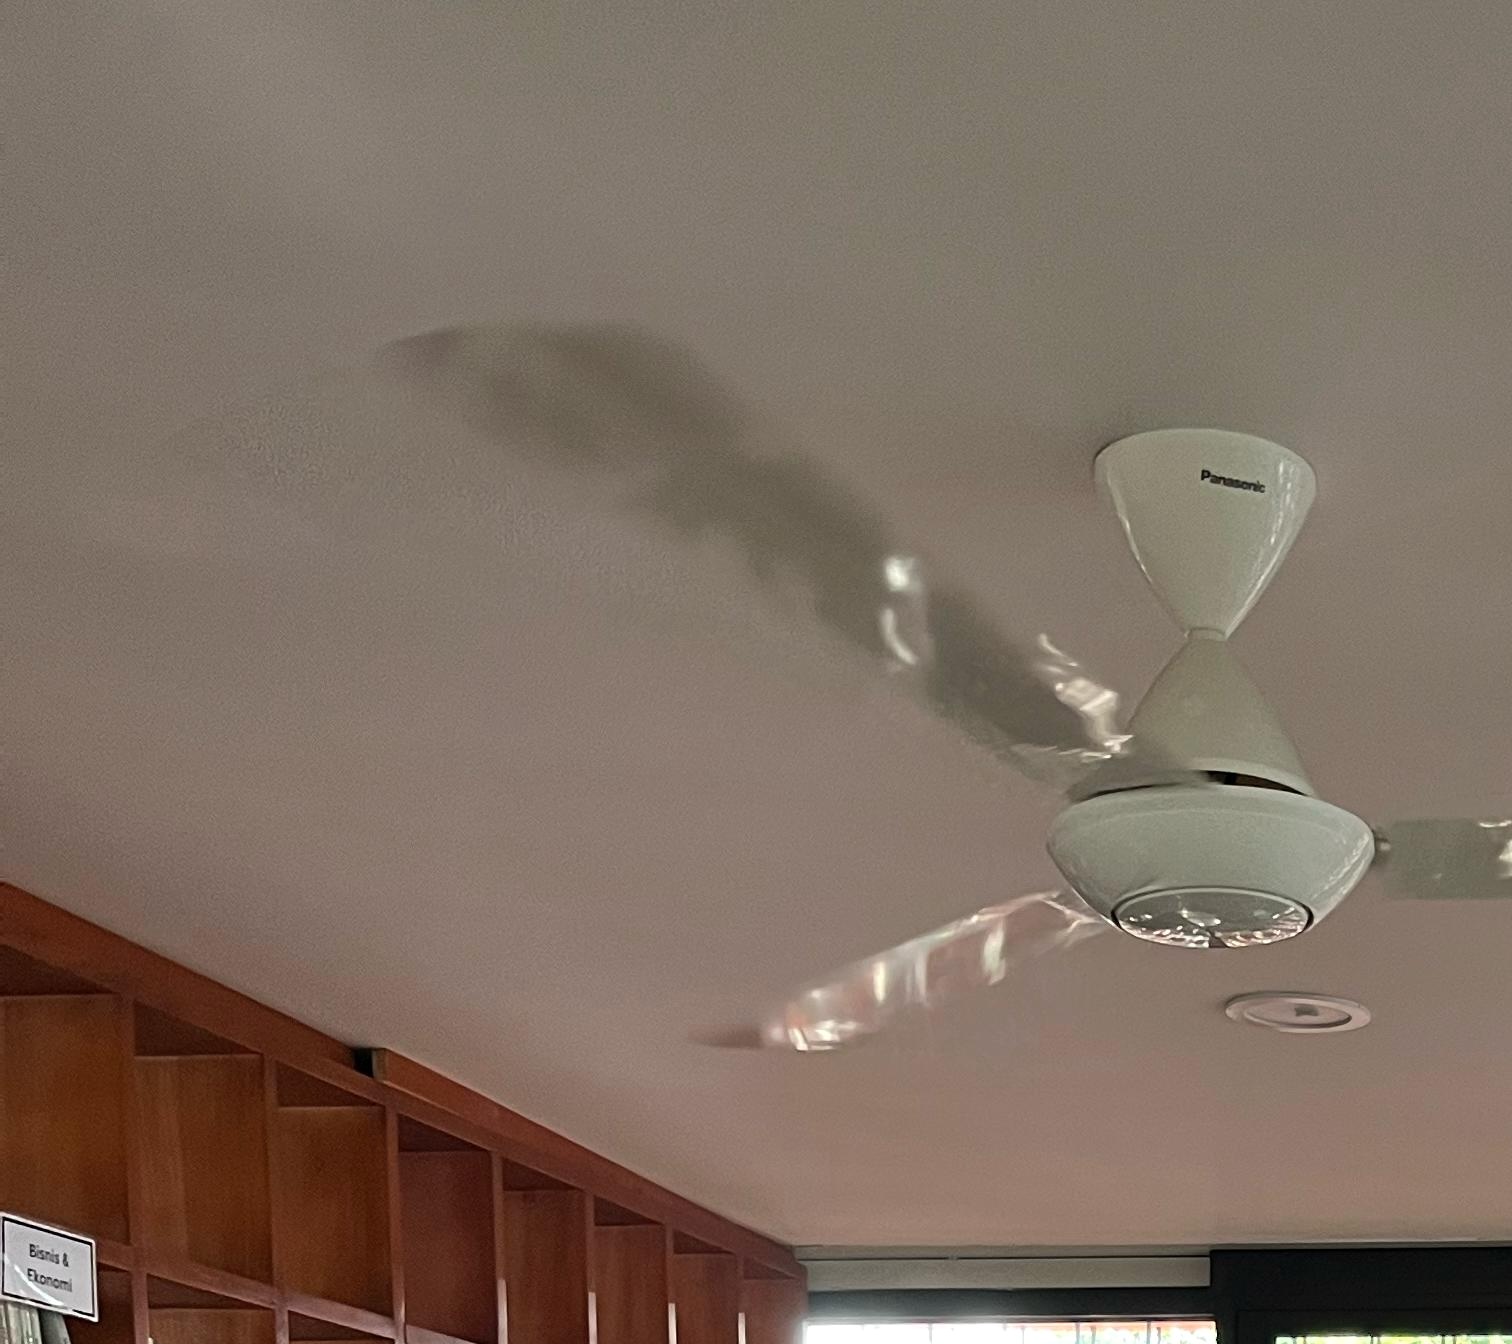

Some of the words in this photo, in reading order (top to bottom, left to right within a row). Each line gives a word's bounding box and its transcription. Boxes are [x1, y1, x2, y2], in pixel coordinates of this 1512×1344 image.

[1200, 469, 1266, 494] Panasonic
[29, 1243, 60, 1265] Bisnis
[27, 1267, 73, 1293] Ekonomi
